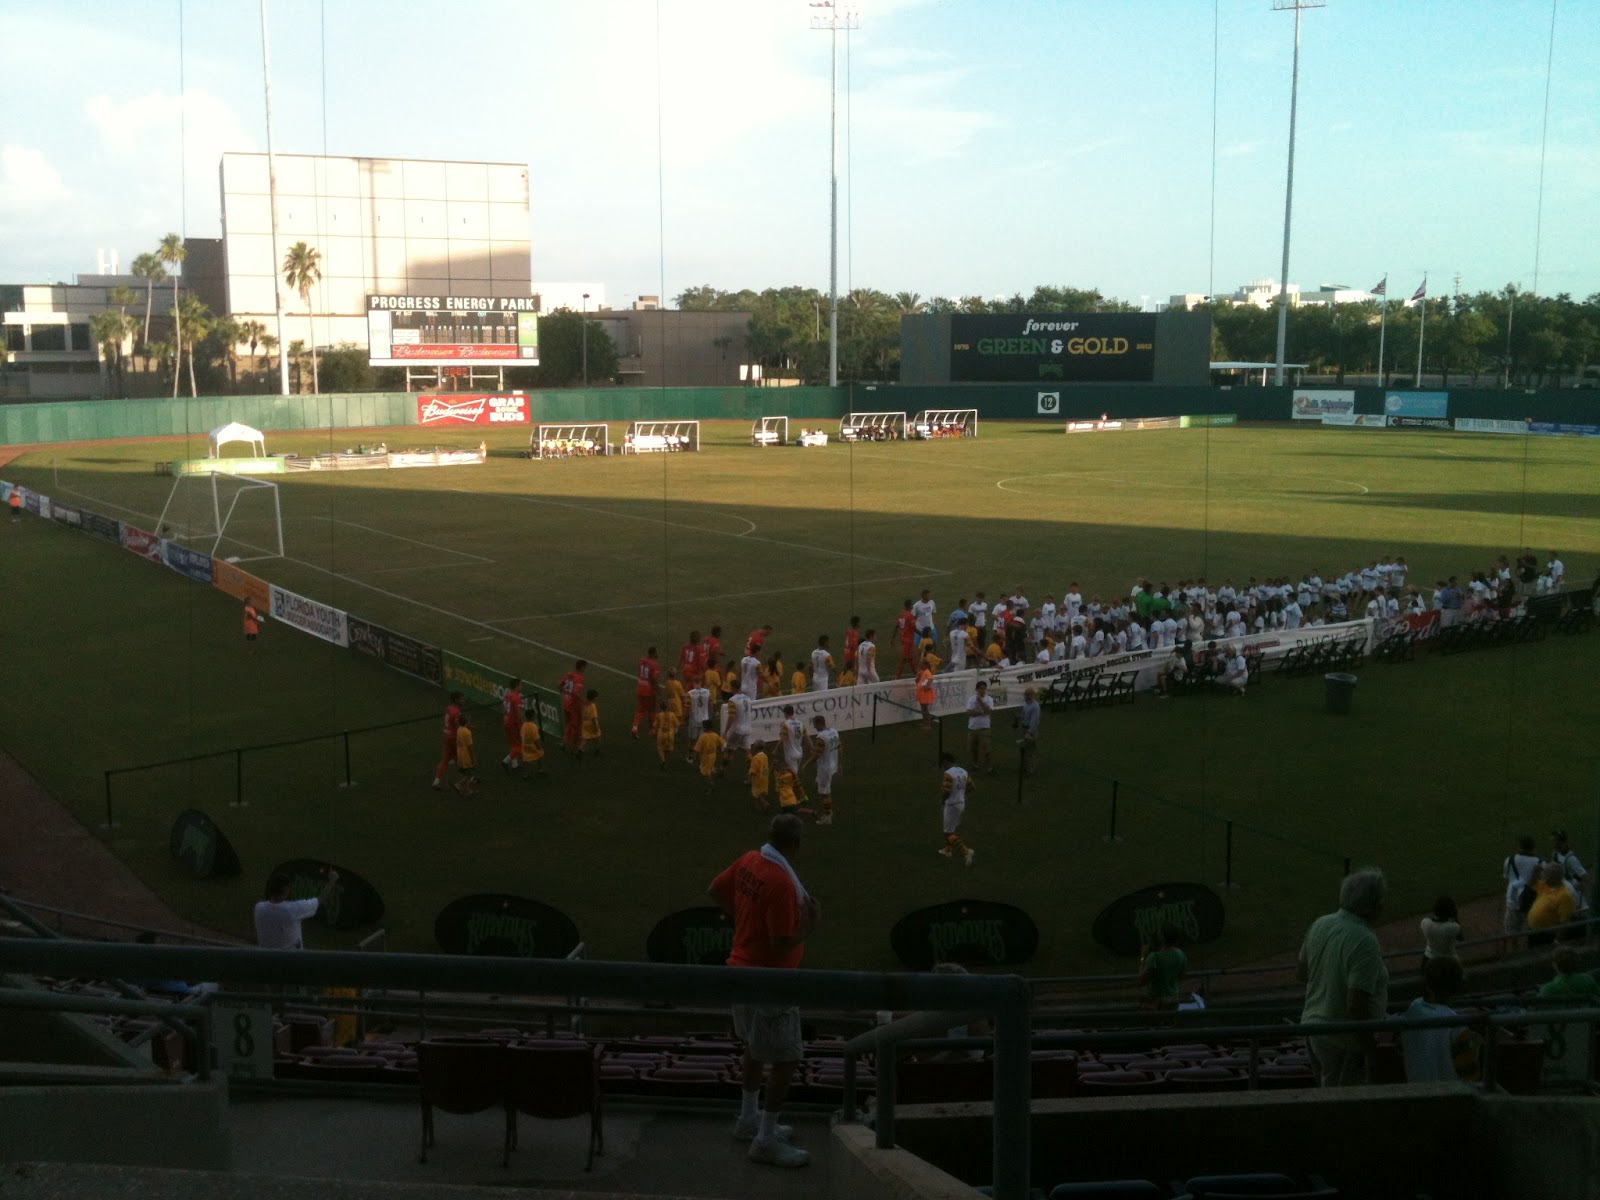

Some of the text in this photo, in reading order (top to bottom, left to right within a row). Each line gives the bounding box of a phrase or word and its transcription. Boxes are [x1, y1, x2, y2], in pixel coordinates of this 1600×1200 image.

[371, 297, 534, 310] PROGRESS ENERGY PARK
[1022, 319, 1079, 335] forever
[393, 346, 516, 359] Budweiser Budweiser
[977, 337, 1129, 355] GREEN & GOLD
[489, 398, 524, 407] GRAB
[1044, 396, 1054, 409] 12
[422, 404, 484, 417] Budweiser
[490, 412, 524, 421] BUDS
[286, 594, 314, 617] FLORIDA
[314, 602, 340, 624] YOUTH
[1017, 674, 1034, 684] THE
[1035, 663, 1070, 680] WORLD'S
[1106, 657, 1131, 668] SOCCER
[795, 702, 807, 715] &
[812, 688, 893, 713] COUNTRY
[233, 1013, 255, 1058] 8
